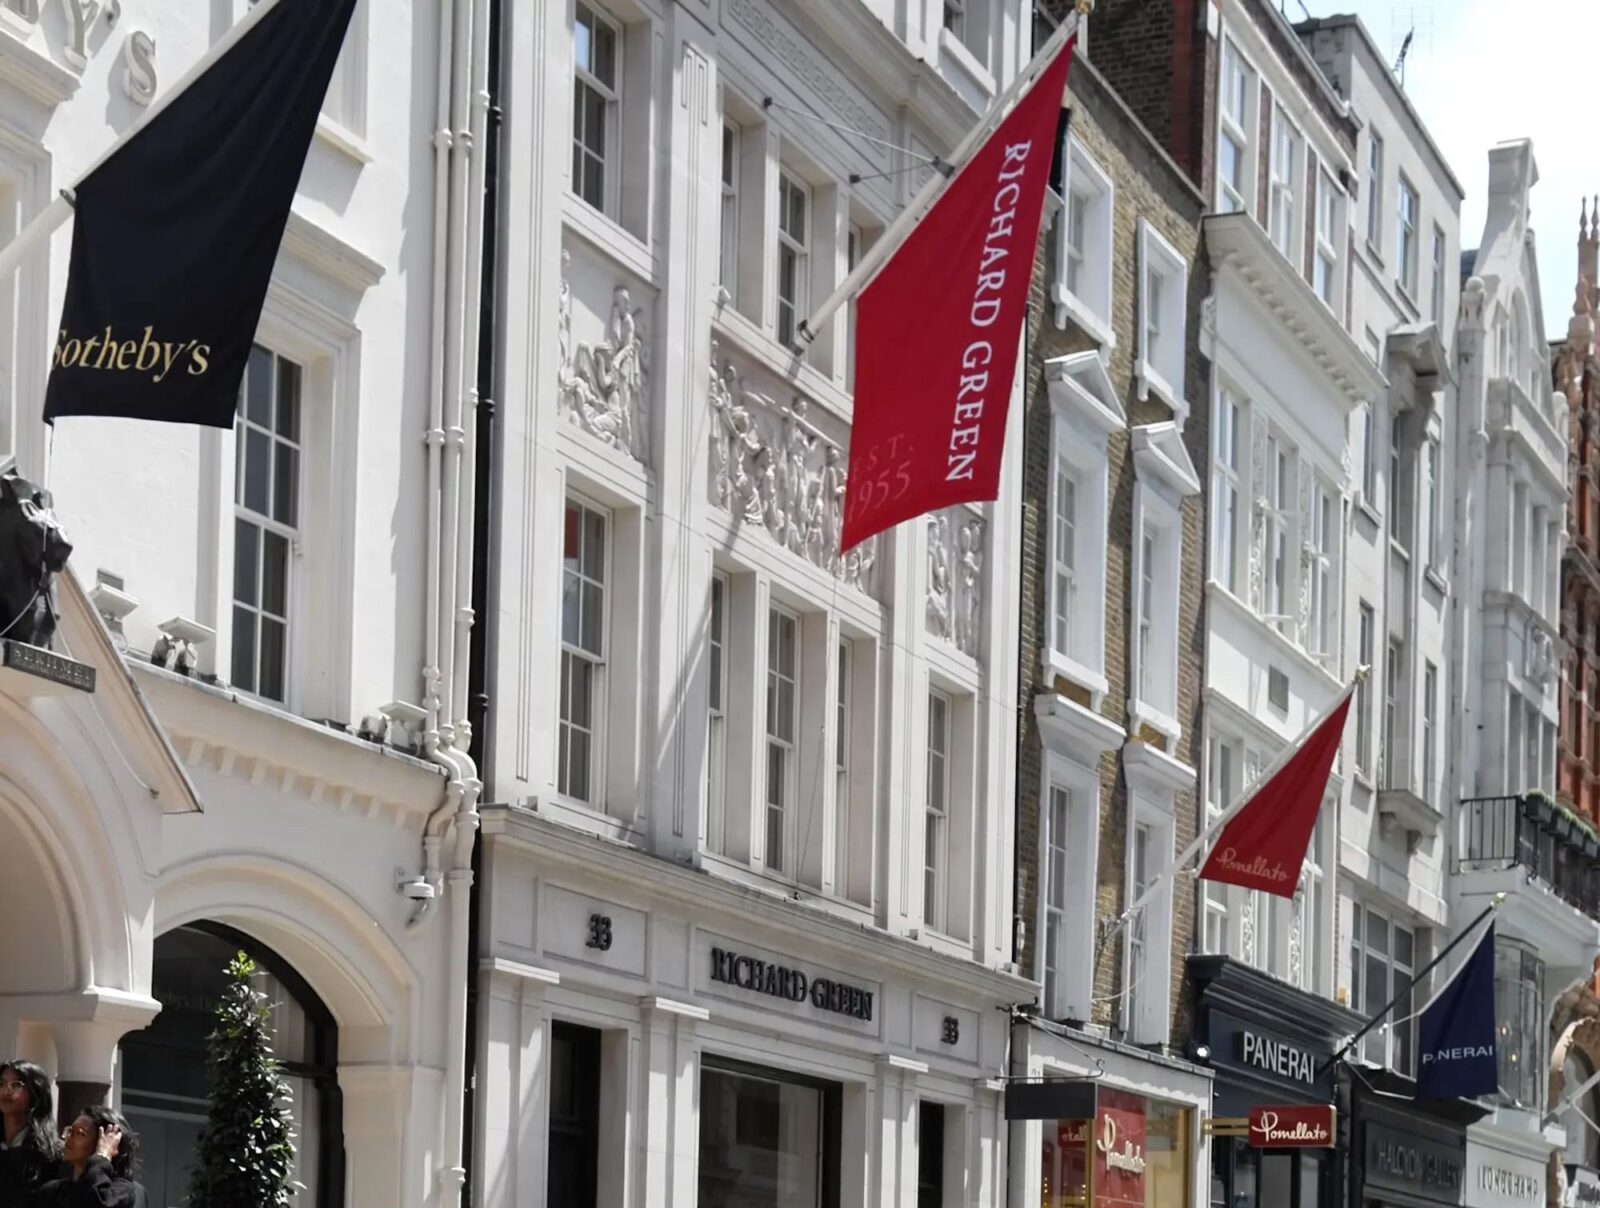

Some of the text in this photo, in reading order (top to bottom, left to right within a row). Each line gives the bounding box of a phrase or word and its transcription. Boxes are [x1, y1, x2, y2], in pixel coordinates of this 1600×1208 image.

[946, 139, 1032, 482] RICHARD GREEN
[848, 460, 912, 522] 1955
[1216, 847, 1289, 882] Pomellato
[585, 913, 613, 951] 33
[711, 947, 874, 1022] RICHARD GREEN
[941, 1016, 960, 1046] 33
[1243, 1031, 1315, 1085] PANERAI
[1422, 1045, 1493, 1064] PNERAI
[1097, 1113, 1146, 1174] Pomellato
[1251, 1110, 1328, 1142] Pomellato
[1478, 1165, 1539, 1202] LONGCHAMP
